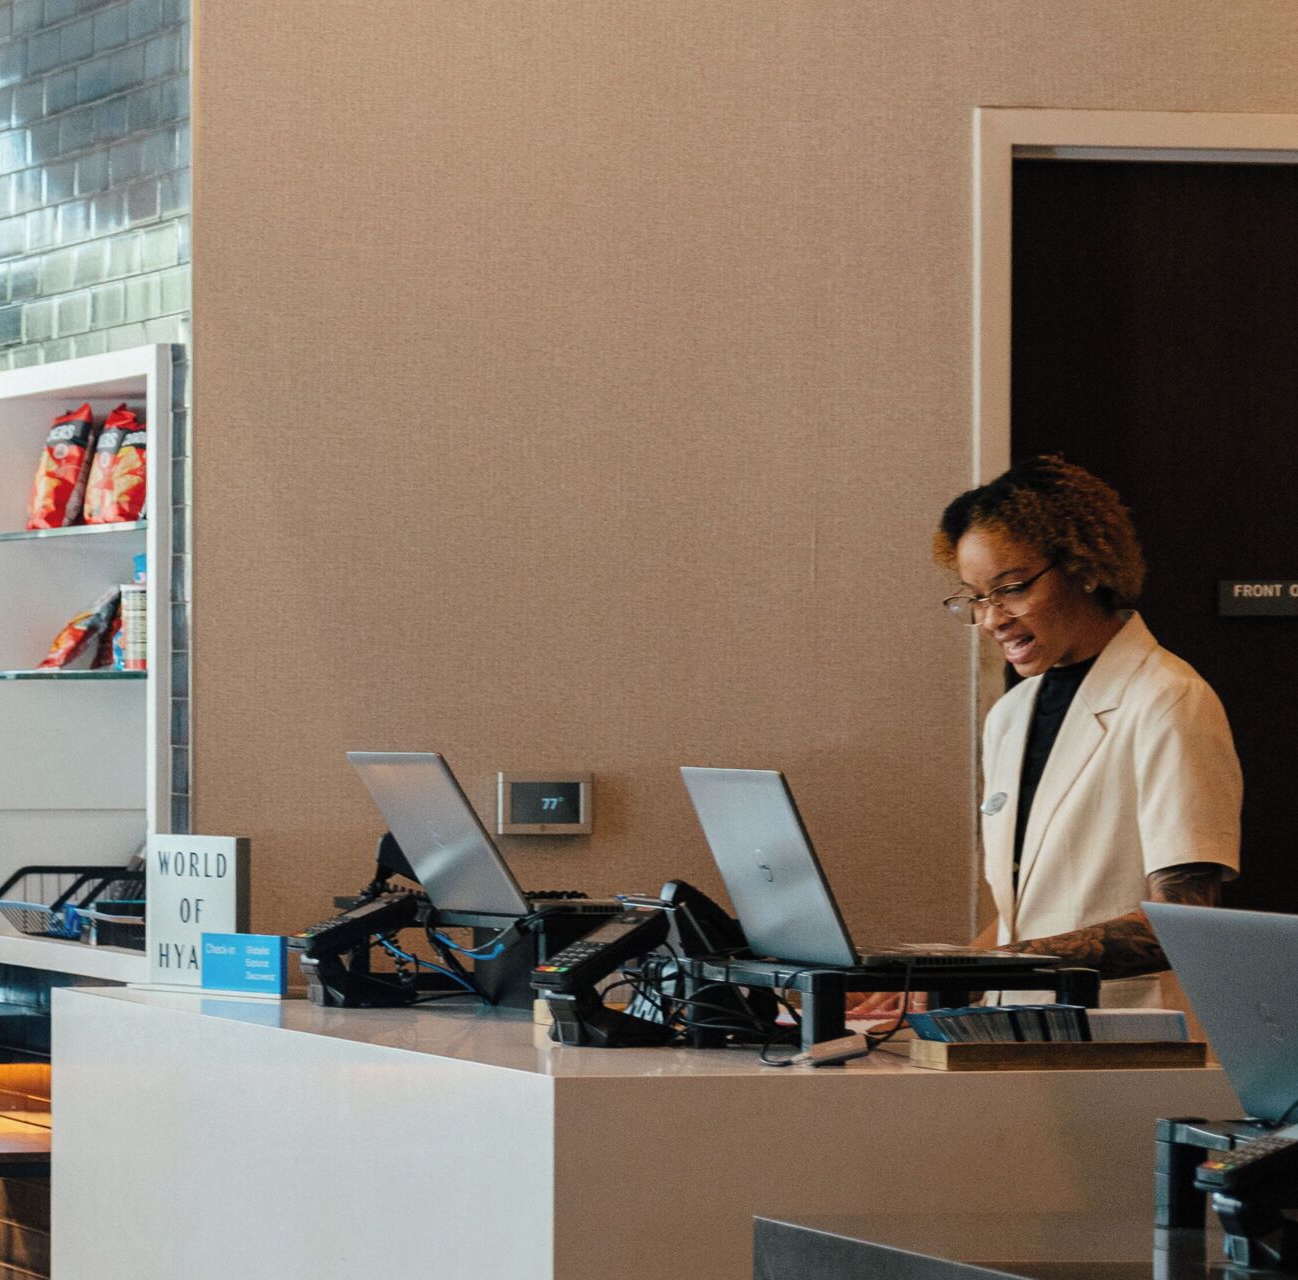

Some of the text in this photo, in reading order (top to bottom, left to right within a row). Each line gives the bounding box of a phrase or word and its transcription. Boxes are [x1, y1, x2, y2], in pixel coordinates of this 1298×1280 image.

[1233, 584, 1282, 597] FRONT
[158, 851, 227, 878] WORLD
[180, 898, 204, 923] OF
[159, 943, 199, 969] HYA
